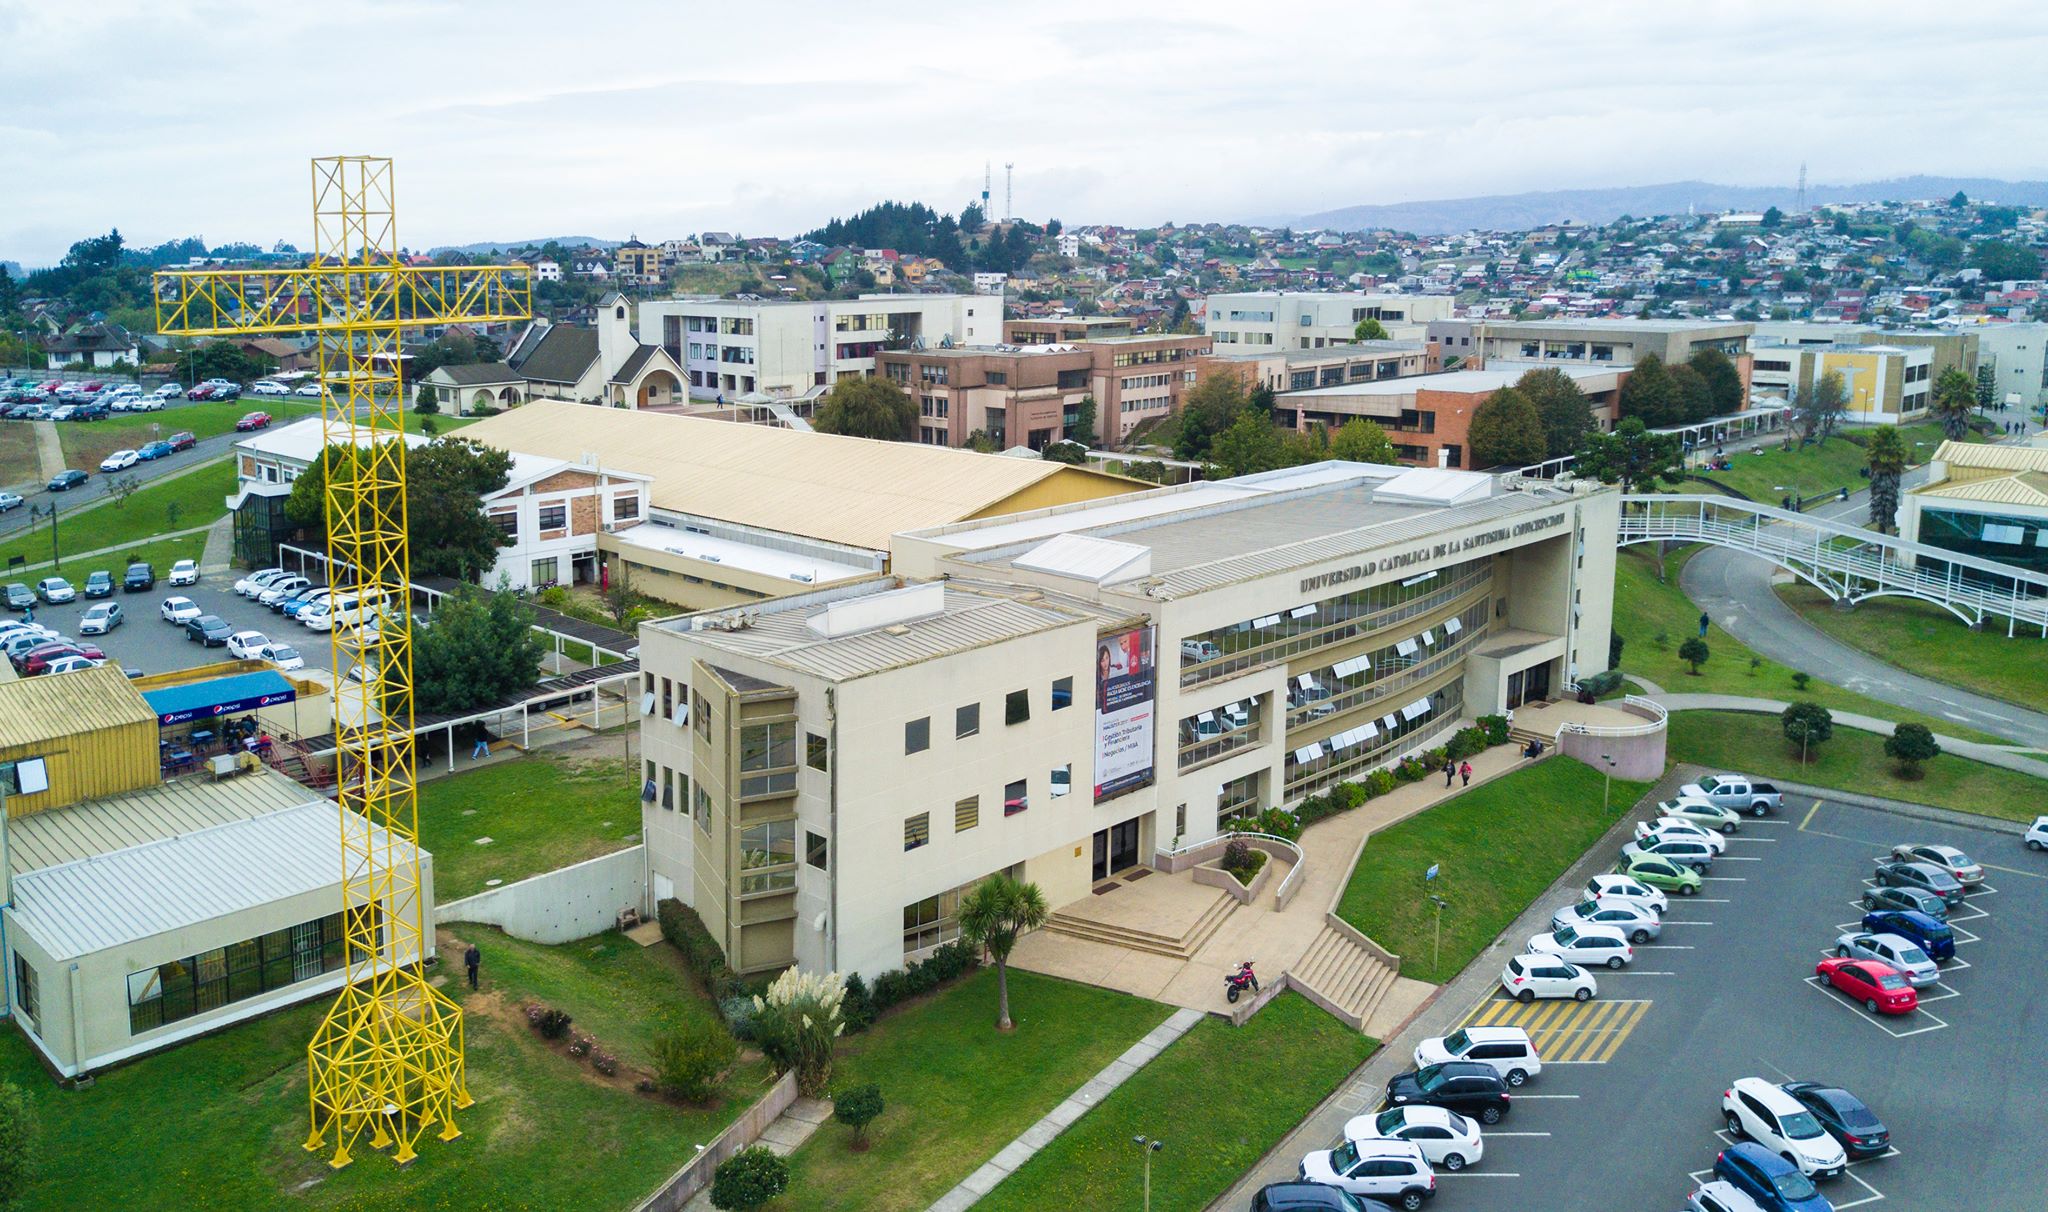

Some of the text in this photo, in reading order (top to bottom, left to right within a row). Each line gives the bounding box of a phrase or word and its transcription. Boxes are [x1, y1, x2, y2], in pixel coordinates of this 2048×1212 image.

[1300, 512, 1566, 593] UNIVERSIDAD CATOLICA DE LA SANTISIMA CONCEPCION
[269, 694, 287, 703] pepsi
[223, 703, 241, 712] pepsi
[174, 712, 193, 721] pepsi
